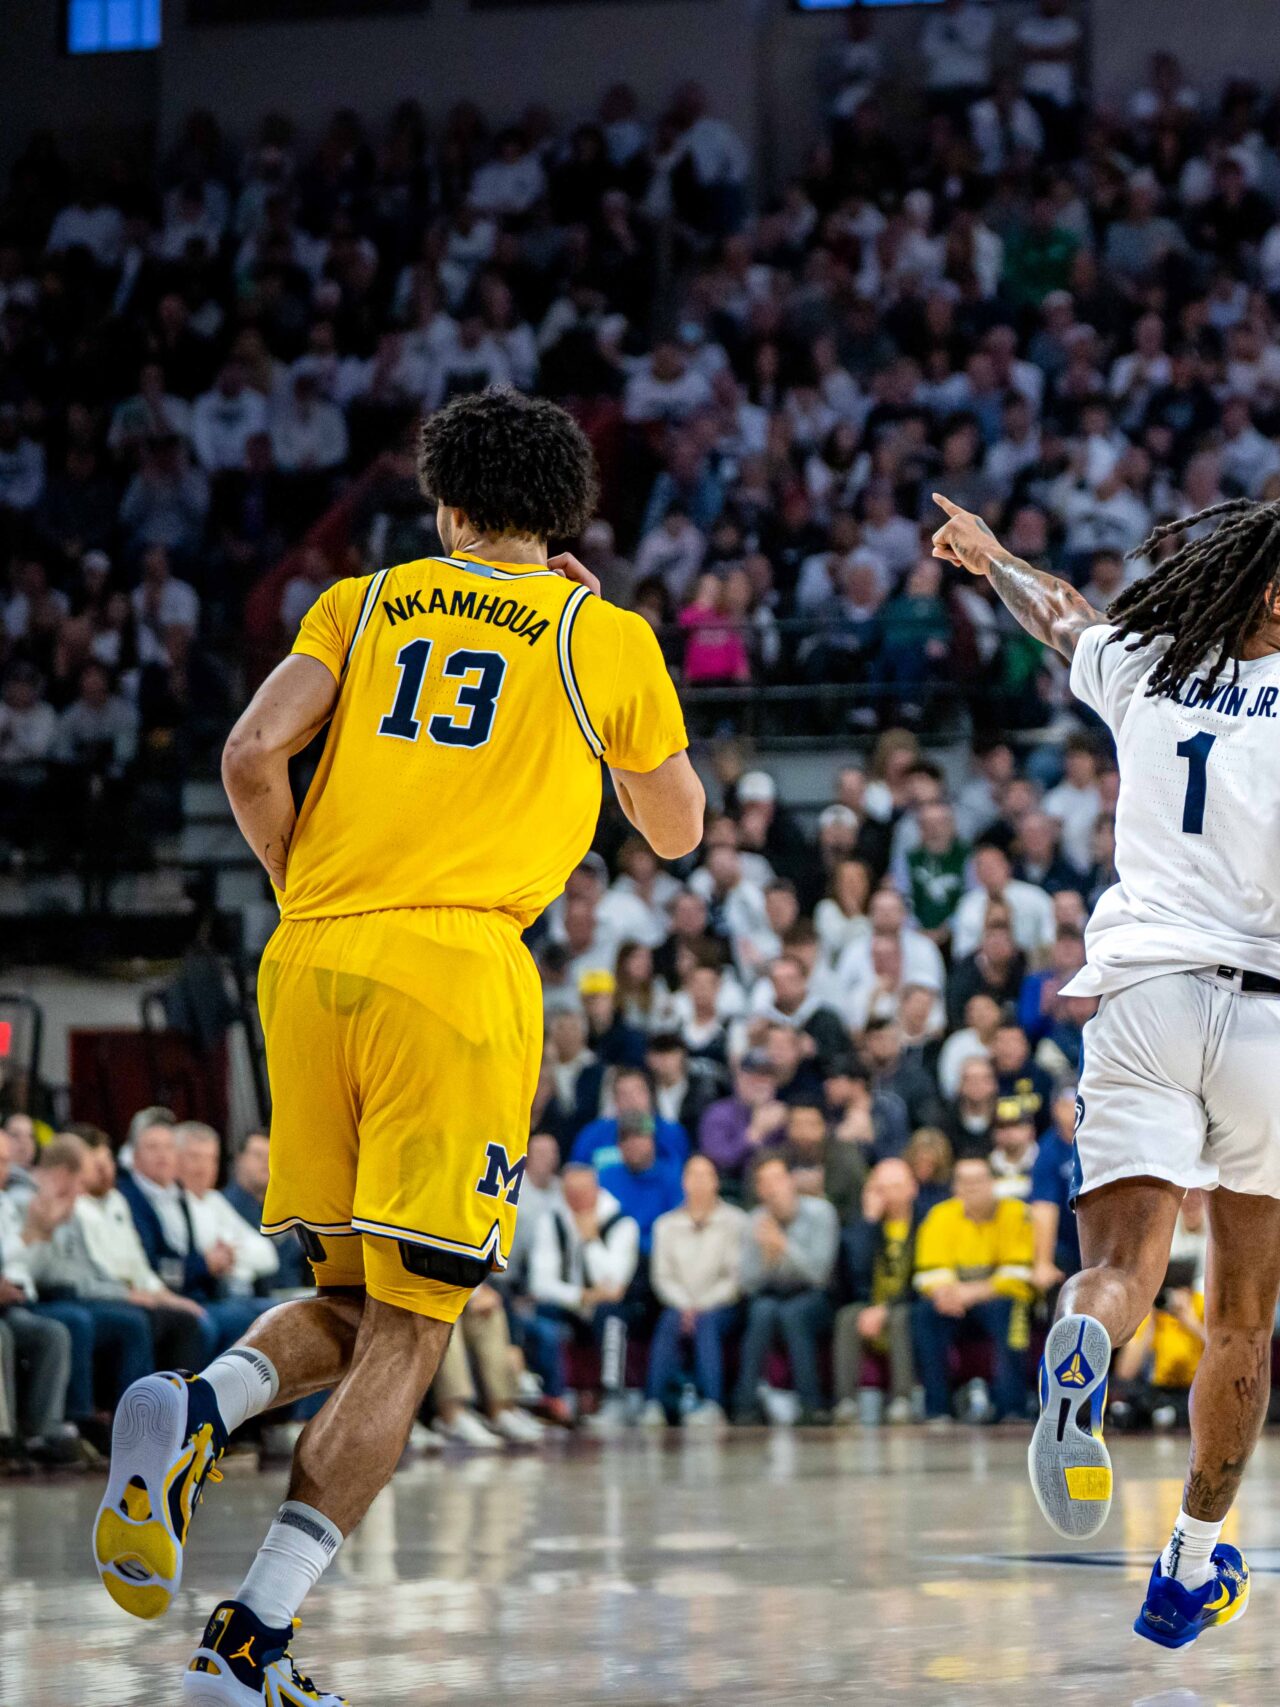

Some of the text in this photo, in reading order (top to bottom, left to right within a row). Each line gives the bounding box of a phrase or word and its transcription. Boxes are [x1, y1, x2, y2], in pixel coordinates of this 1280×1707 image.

[383, 588, 550, 646] NKAMHOUA
[377, 637, 508, 749] 13
[1247, 686, 1279, 718] JR.
[1176, 731, 1217, 835] 1
[475, 1141, 527, 1207] M
